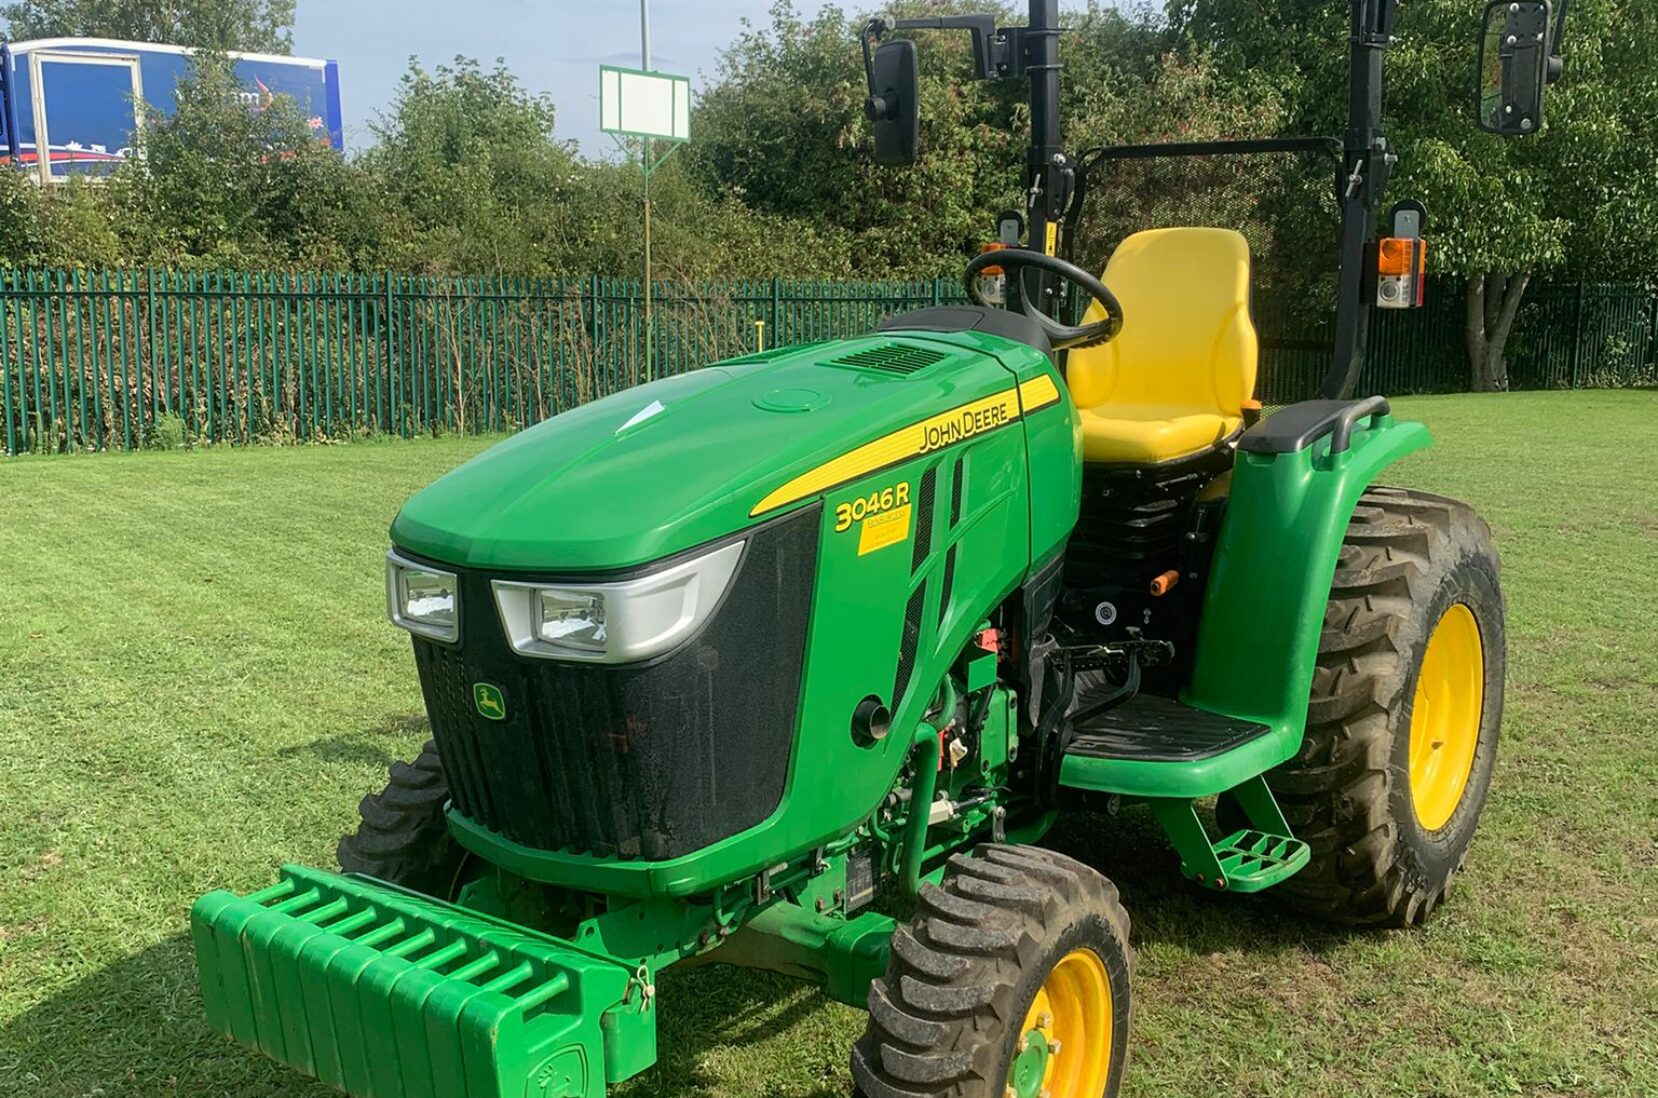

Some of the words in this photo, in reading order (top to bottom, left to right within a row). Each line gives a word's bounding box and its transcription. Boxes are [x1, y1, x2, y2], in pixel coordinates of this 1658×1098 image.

[919, 418, 961, 451] JOHN
[963, 403, 1008, 435] DEERE
[834, 481, 910, 533] 3046R
